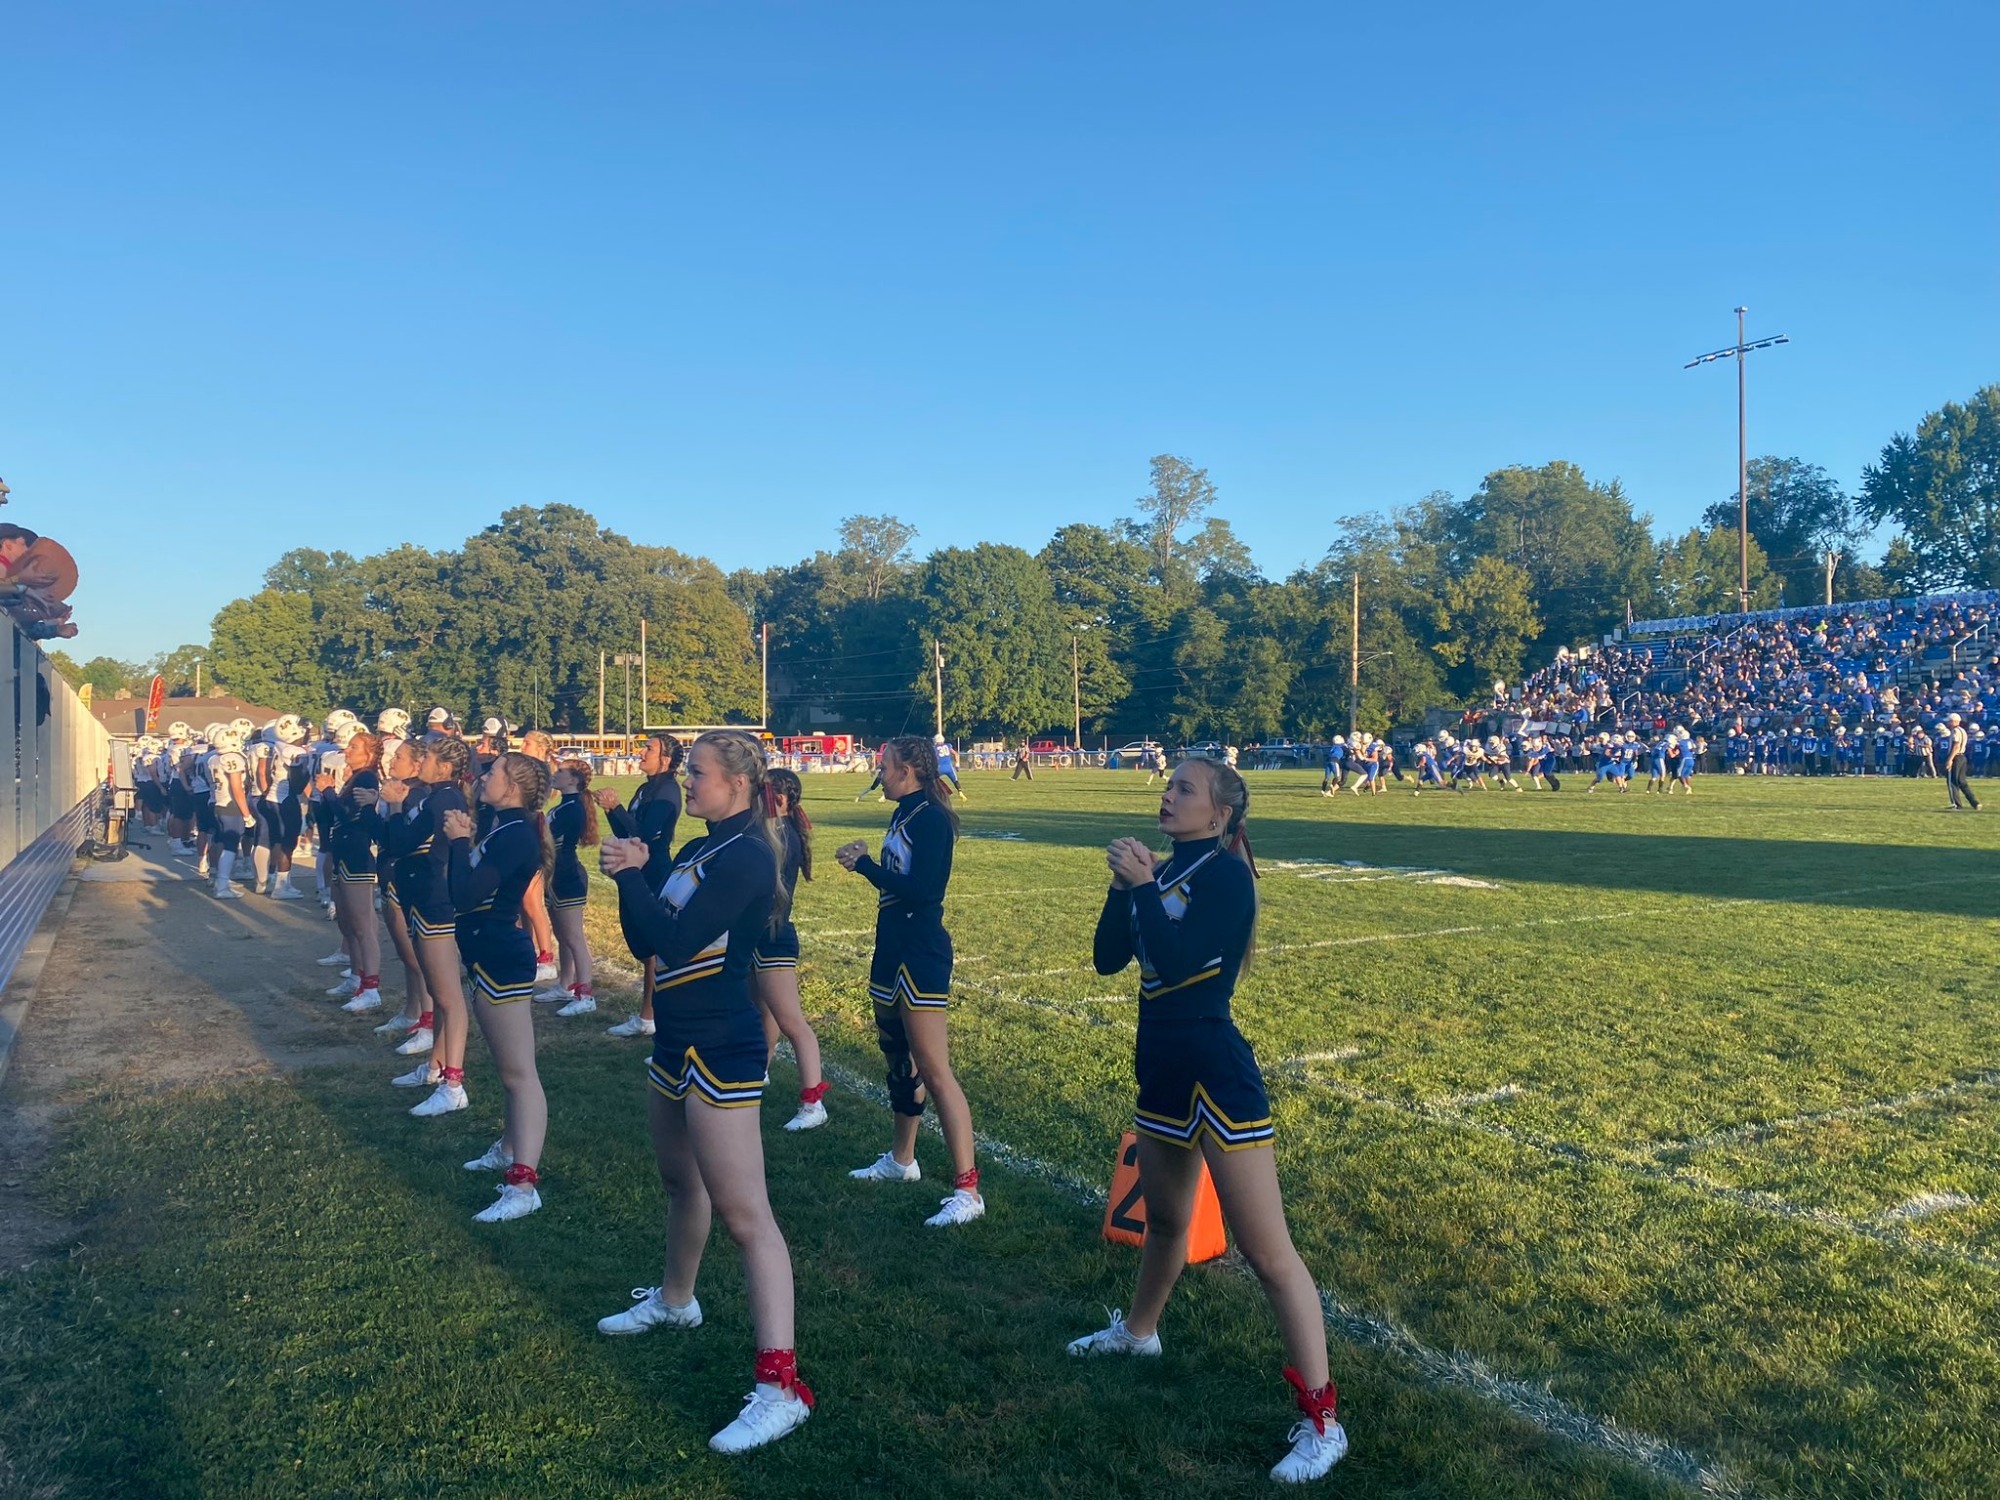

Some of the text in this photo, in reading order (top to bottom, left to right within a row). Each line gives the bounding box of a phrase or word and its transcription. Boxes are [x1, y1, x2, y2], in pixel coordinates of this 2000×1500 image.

[937, 744, 950, 757] 30
[226, 760, 238, 771] 35
[1037, 752, 1107, 767] LIONS
